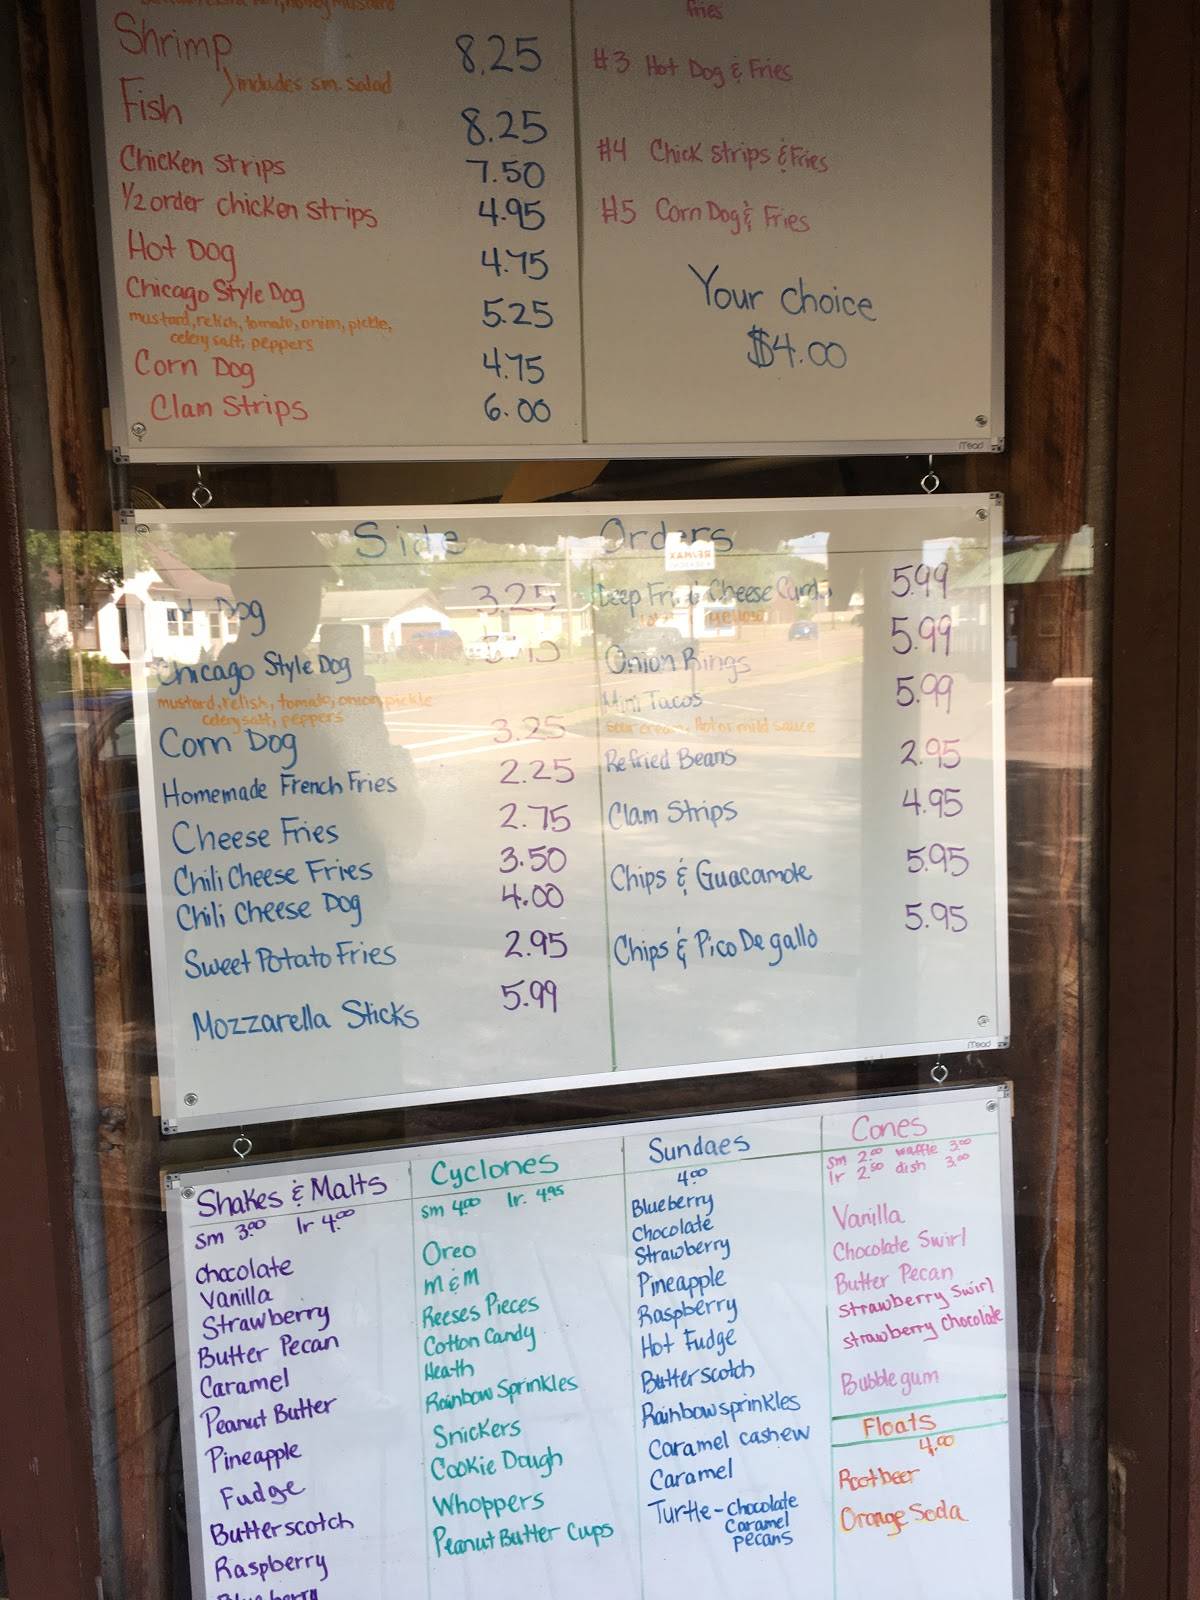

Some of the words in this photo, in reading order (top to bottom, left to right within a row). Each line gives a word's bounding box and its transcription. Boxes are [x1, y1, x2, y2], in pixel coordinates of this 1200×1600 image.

[113, 12, 232, 71] Shrimp
[456, 35, 542, 76] 8.25
[647, 55, 678, 76] Hot
[689, 59, 725, 88] Dog
[749, 58, 793, 81] Fries
[120, 76, 182, 124] Fish
[461, 108, 547, 145] 8.25
[120, 144, 203, 175] Chicken
[597, 137, 626, 162] #4
[651, 139, 703, 162] Chick
[465, 159, 544, 189] 7.50
[478, 198, 545, 231] 4.95
[602, 195, 637, 225] #5
[656, 198, 700, 222] Corn
[708, 202, 740, 234] Dog
[764, 205, 810, 233] Fries
[128, 228, 176, 263] Hot
[189, 239, 236, 282] Dog
[481, 248, 549, 281] 4.75
[126, 276, 209, 310] Chicago
[215, 279, 262, 309] Style
[269, 282, 305, 312] Dog
[689, 263, 763, 310] Your
[482, 298, 554, 329] 5.25
[251, 338, 314, 352] peppers
[747, 324, 847, 368] $4.00
[135, 349, 198, 378] Corn
[213, 356, 255, 387] Dog
[483, 352, 544, 385] 4.75
[151, 394, 212, 421] Clam
[223, 395, 308, 426] Strips
[484, 393, 551, 423] 6.00
[353, 521, 466, 558] Side
[600, 518, 733, 554] Orders
[892, 562, 949, 598] 5.99
[890, 614, 952, 656] 5.99
[264, 651, 313, 683] Style
[319, 655, 351, 684] Dog
[682, 648, 751, 683] Rings
[646, 690, 702, 709] Tacos
[896, 674, 953, 713] 5.99
[491, 716, 565, 743] 3.25
[159, 728, 231, 759] Corn
[249, 728, 297, 769] Dog
[605, 749, 669, 772] Refried
[679, 748, 736, 769] Beans
[901, 739, 961, 769] 2.95
[500, 757, 575, 784] 2.25
[162, 781, 267, 808] Homemade
[281, 773, 342, 798] French
[348, 771, 398, 794] Fries
[902, 788, 963, 817] 4.95
[499, 803, 570, 832] 2.75
[609, 802, 658, 830] Clam
[668, 800, 737, 828] Strips
[172, 820, 270, 854] Cheese
[281, 817, 339, 844] Fries
[500, 846, 567, 873] 3.50
[907, 843, 969, 876] 5.95
[174, 865, 222, 895] Chili
[228, 865, 297, 888] Cheese
[306, 859, 373, 884] Fries
[611, 864, 666, 895] Chips
[176, 903, 225, 931] Chili
[323, 894, 362, 927] Dog
[502, 884, 564, 909] 4.00
[905, 903, 967, 933] 5.95
[184, 949, 251, 979] Sweet
[257, 946, 330, 973] Potato
[337, 942, 397, 966] Fries
[505, 930, 567, 958] 2.95
[614, 933, 668, 970] Chips
[695, 929, 736, 957] Pico
[743, 929, 765, 950] De
[769, 924, 818, 966] gallo
[501, 980, 557, 1013] 5.99
[194, 1004, 330, 1041] Mozzarella
[342, 999, 419, 1030] Sticks
[852, 1115, 928, 1142] Cones
[648, 1135, 750, 1163] Sundaes
[431, 1154, 559, 1188] Cyclones
[896, 1160, 926, 1174] dish
[197, 1188, 284, 1219] Shakes
[311, 1174, 388, 1201] Malts
[631, 1193, 714, 1218] Blueberry
[832, 1203, 905, 1230] Vanilla
[422, 1242, 476, 1266] Oreo
[833, 1233, 910, 1263] Chocolate
[918, 1227, 967, 1249] Swirl
[638, 1266, 727, 1298] Pineapple
[835, 1271, 890, 1295] Butter
[900, 1264, 954, 1282] Pecan
[202, 1306, 330, 1339] Strawberry
[422, 1307, 481, 1328] Reeses
[485, 1294, 539, 1314] Pieces
[638, 1298, 737, 1328] Raspberry
[199, 1345, 269, 1369] Butter
[281, 1334, 339, 1356] Pecan
[424, 1338, 479, 1356] Cotton
[484, 1324, 535, 1352] Candy
[642, 1333, 675, 1358] Hot
[684, 1327, 737, 1355] Fudge
[200, 1369, 289, 1399] Caramel
[424, 1361, 474, 1380] Heath
[425, 1387, 493, 1413] Rainbow
[497, 1375, 578, 1399] Sprinkles
[204, 1407, 267, 1438] Peanut
[274, 1397, 336, 1424] Butter
[863, 1413, 936, 1438] Floats
[434, 1419, 521, 1450] Snickers
[649, 1437, 730, 1460] Caramel
[205, 1442, 301, 1473] Pineapple
[431, 1457, 496, 1481] Cookie
[501, 1447, 563, 1477] Dough
[650, 1458, 733, 1491] Caramel
[220, 1479, 305, 1510] Fudge
[433, 1490, 544, 1518] Whoppers
[841, 1506, 908, 1537] Orange
[910, 1501, 968, 1522] Soda
[433, 1526, 494, 1558] Peanut
[500, 1526, 559, 1548] Butter
[567, 1522, 614, 1547] Cups
[215, 1554, 328, 1581] Raspberry
